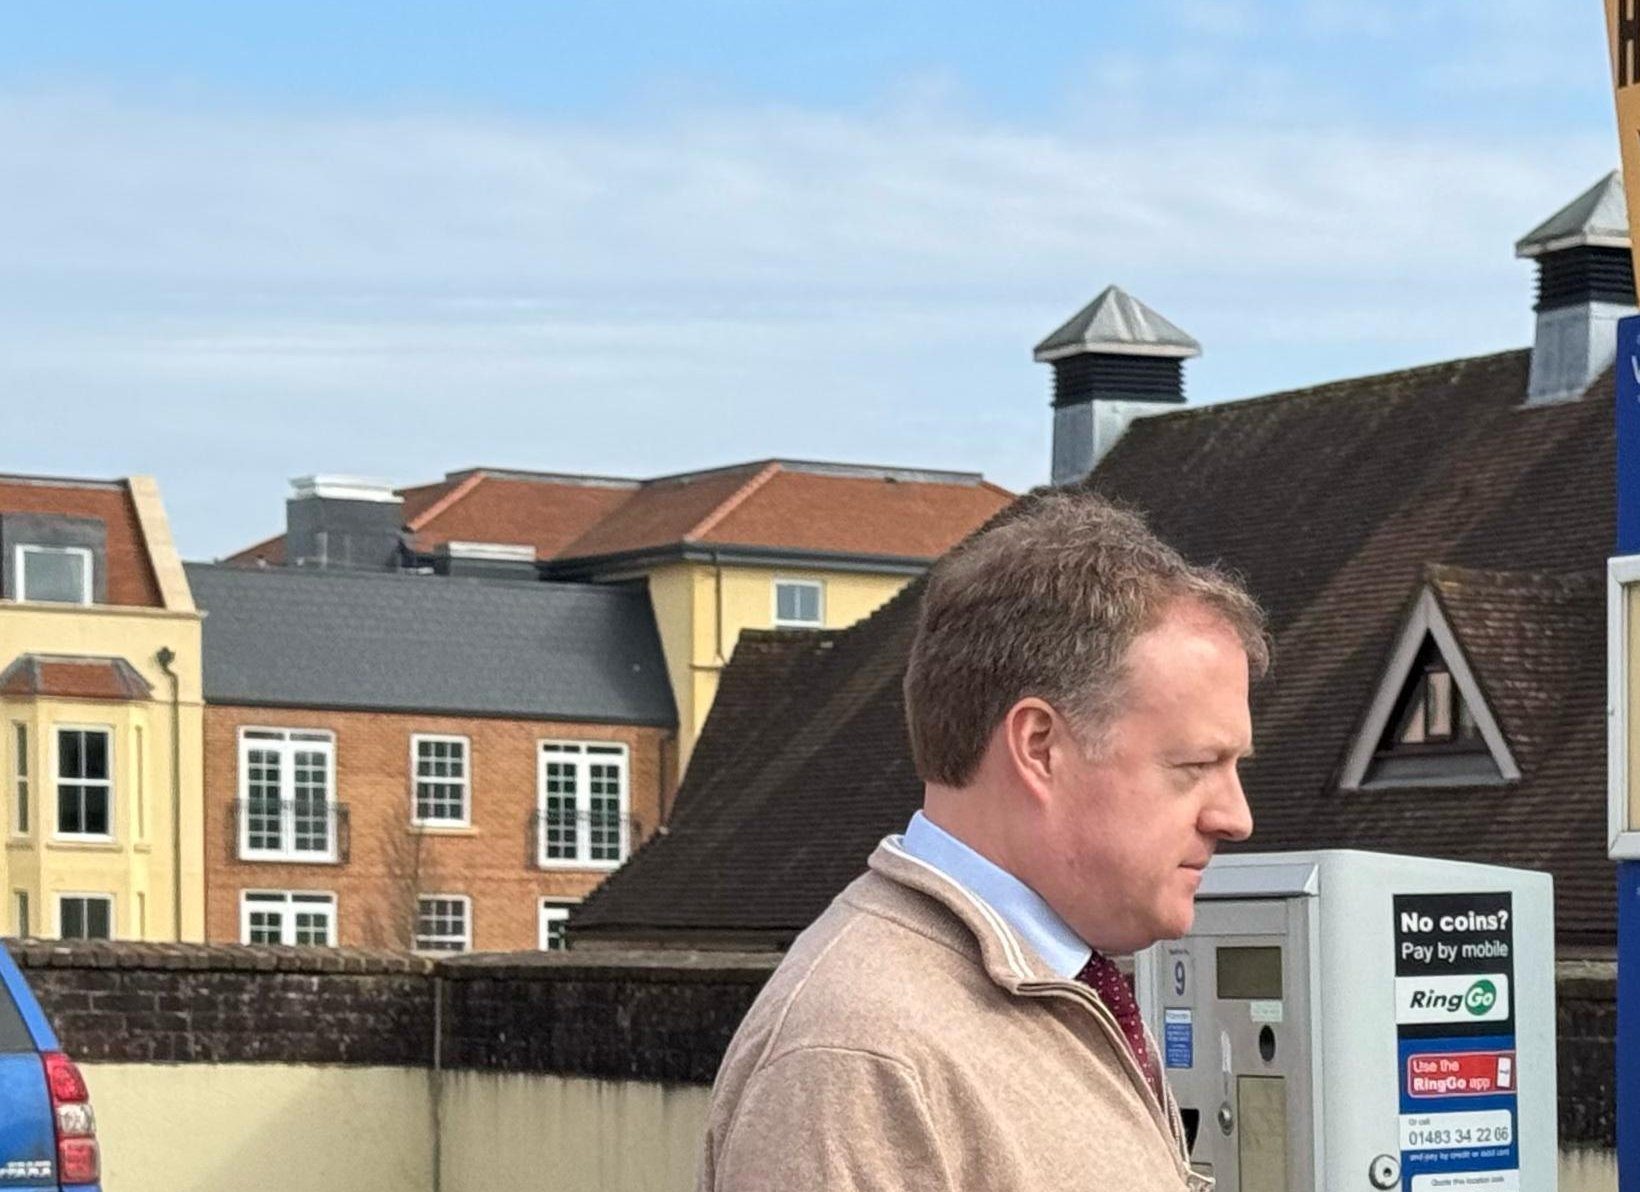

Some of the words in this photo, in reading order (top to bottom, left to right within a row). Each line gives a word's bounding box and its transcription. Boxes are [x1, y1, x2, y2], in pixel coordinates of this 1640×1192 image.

[1401, 912, 1434, 933] No
[1440, 910, 1508, 932] coins?
[1402, 942, 1433, 963] Pay
[1438, 941, 1457, 963] by
[1462, 940, 1509, 958] mobile
[1175, 960, 1186, 996] 9
[1413, 1060, 1438, 1073] Use
[1440, 1059, 1460, 1072] the
[1413, 1076, 1467, 1092] RingGo
[1469, 1078, 1490, 1090] app
[1409, 1130, 1451, 1146] 01483
[1455, 1129, 1472, 1143] 34
[1476, 1128, 1492, 1142] 22
